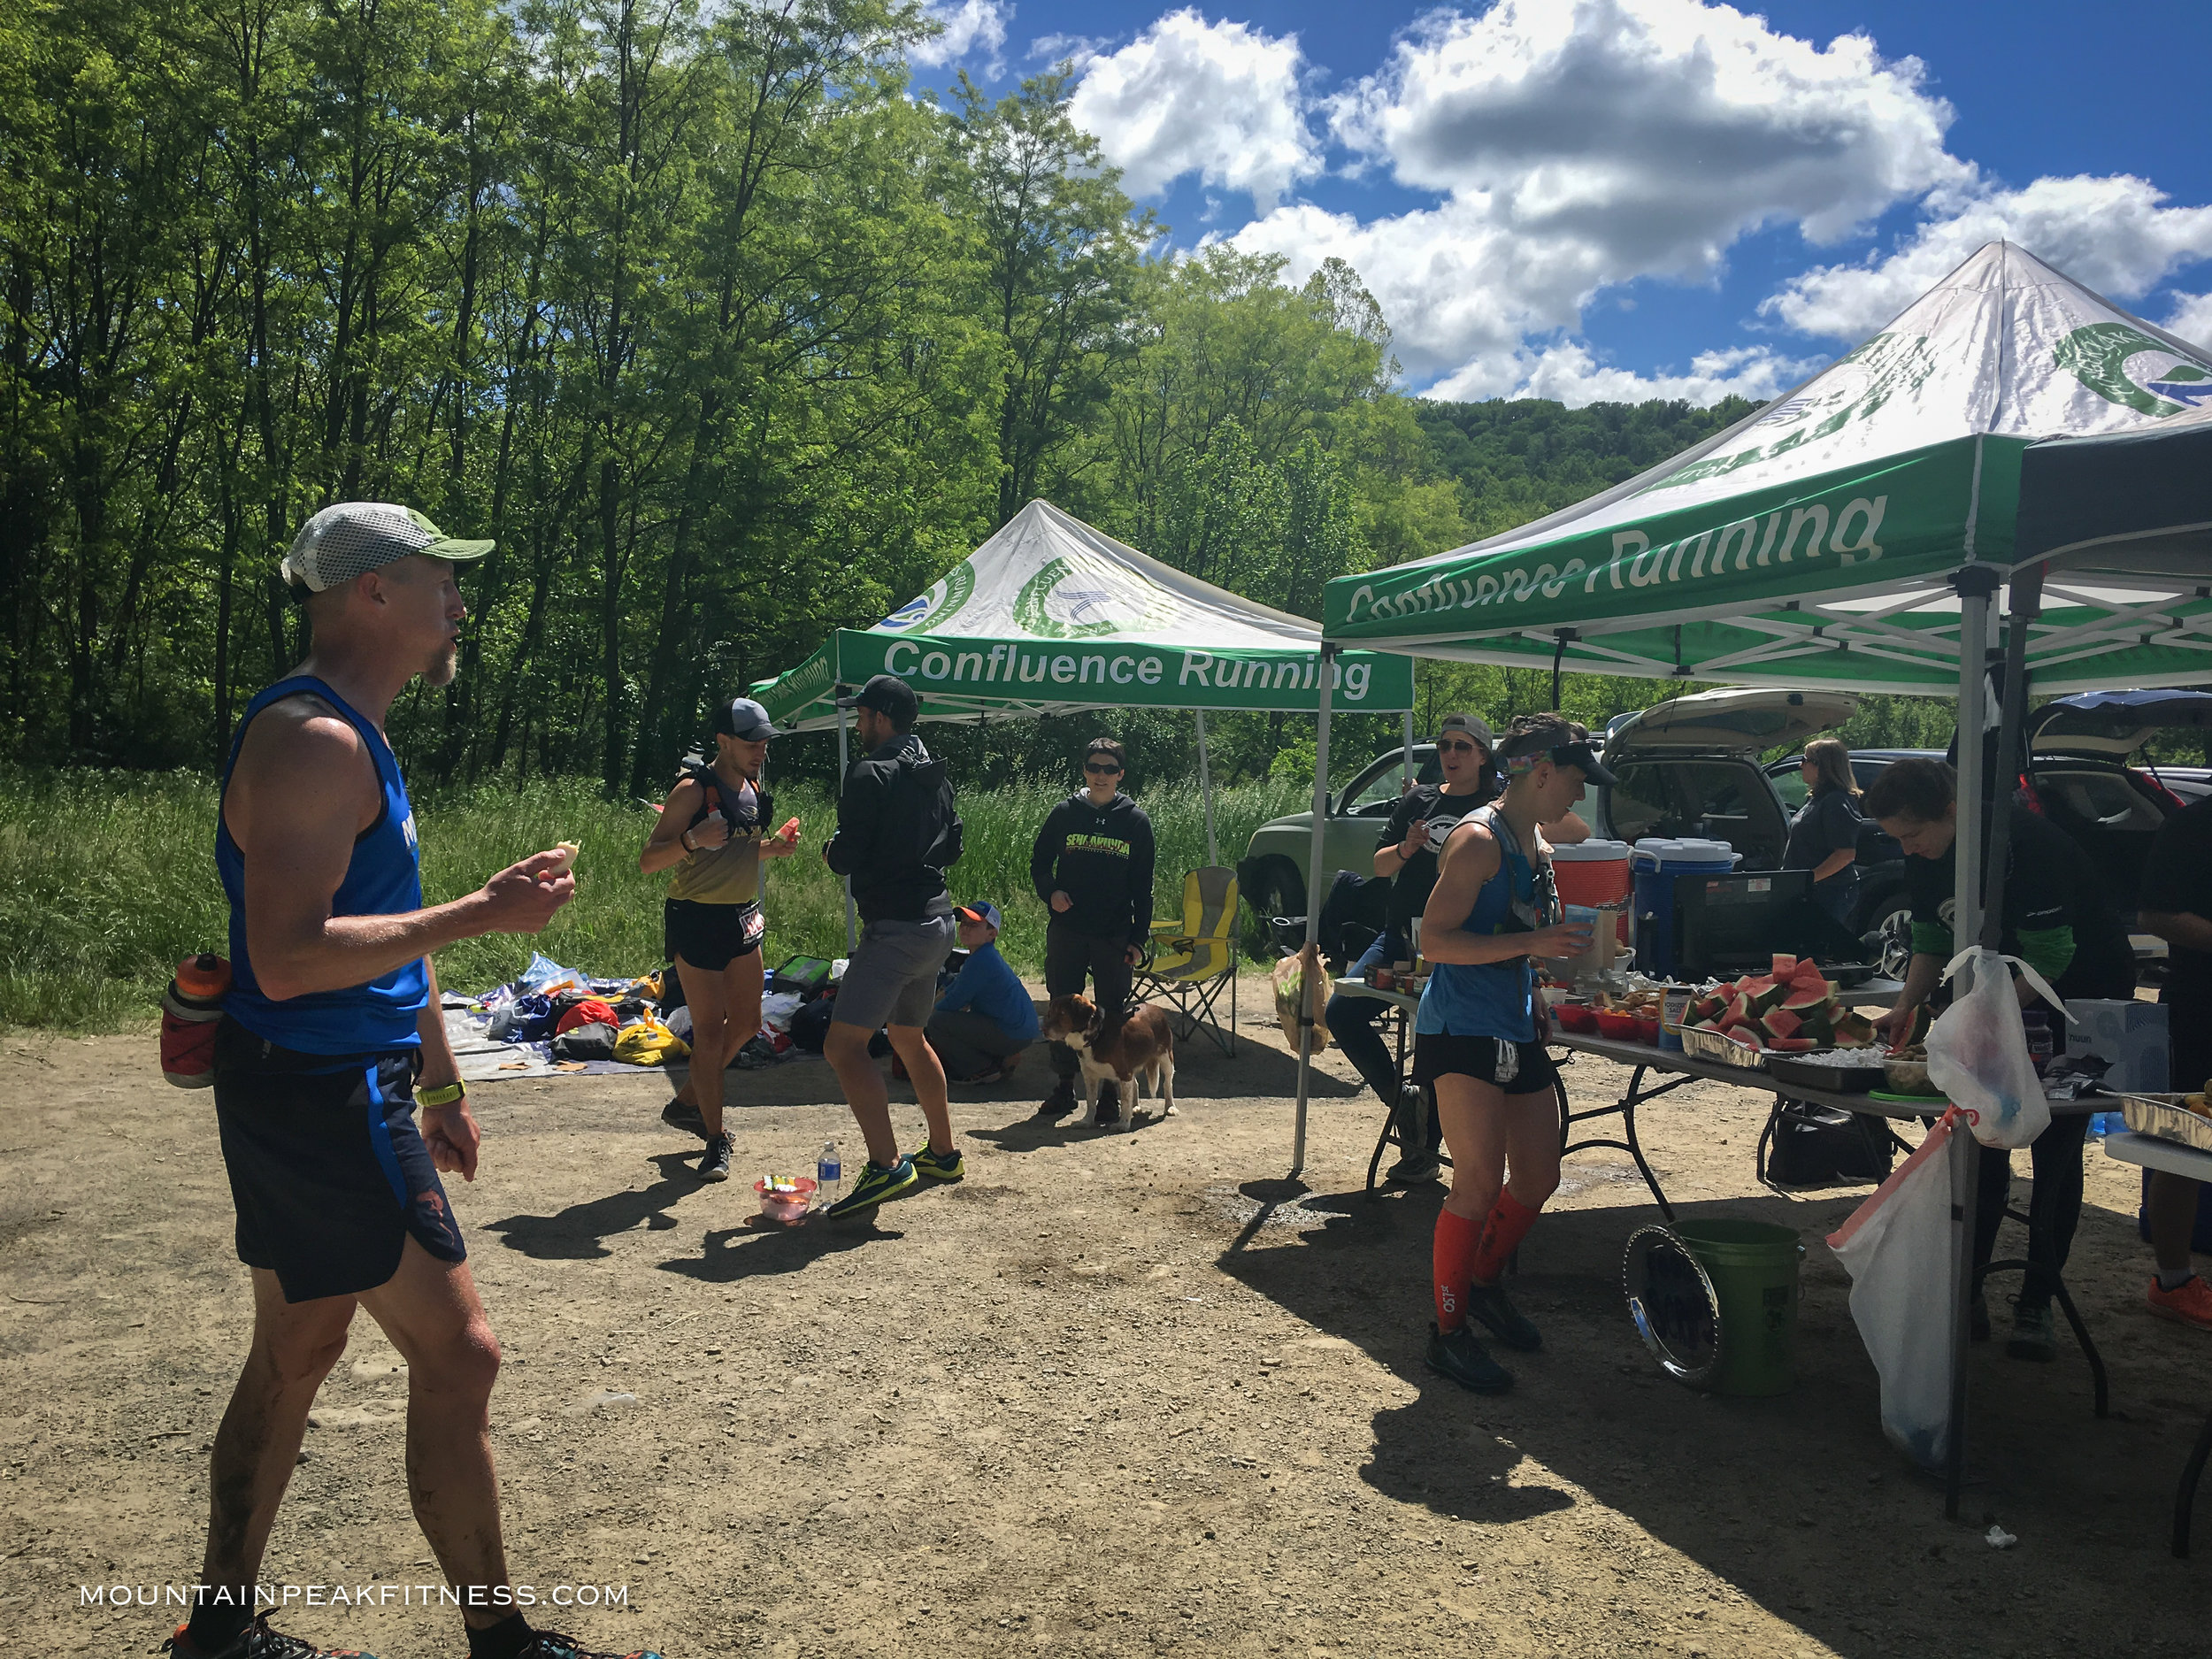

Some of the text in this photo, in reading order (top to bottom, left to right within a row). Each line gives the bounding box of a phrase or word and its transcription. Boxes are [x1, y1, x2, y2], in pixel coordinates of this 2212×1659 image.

[1584, 496, 1889, 594] Running
[884, 640, 1371, 701] Confluence Running
